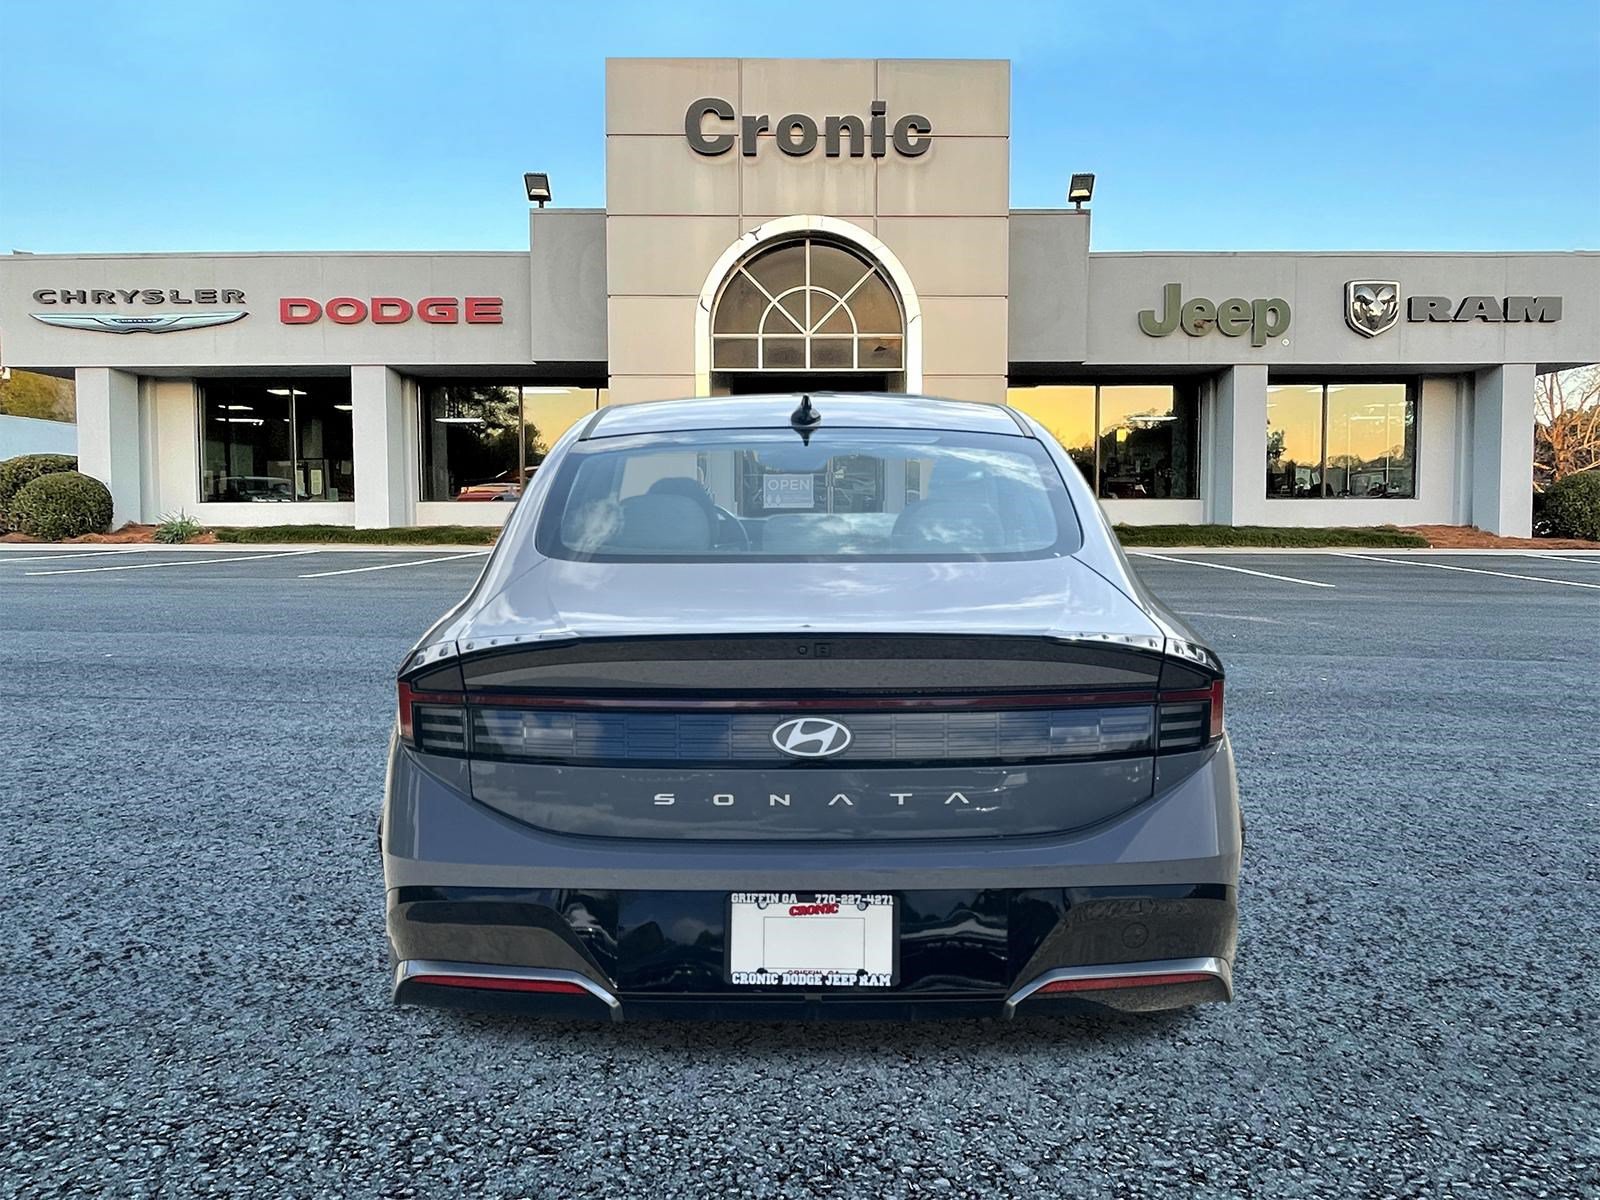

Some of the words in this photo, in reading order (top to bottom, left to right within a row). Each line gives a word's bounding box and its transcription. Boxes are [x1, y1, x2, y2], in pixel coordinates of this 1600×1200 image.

[685, 98, 932, 157] Cronic
[32, 289, 247, 305] CHRYSLER
[280, 298, 503, 324] DODGE
[1138, 283, 1292, 347] Jeep
[1407, 296, 1563, 322] RAM
[767, 480, 810, 490] OPEN
[653, 792, 970, 806] SONATA
[731, 893, 779, 903] GRIFFIN
[782, 893, 798, 903] GA
[815, 894, 894, 905] 770-227-4271
[789, 904, 839, 916] CRONIC
[732, 973, 779, 985] CRONIC
[782, 974, 822, 986] DODGE
[825, 974, 857, 986] JEEP
[859, 974, 891, 987] RAM
